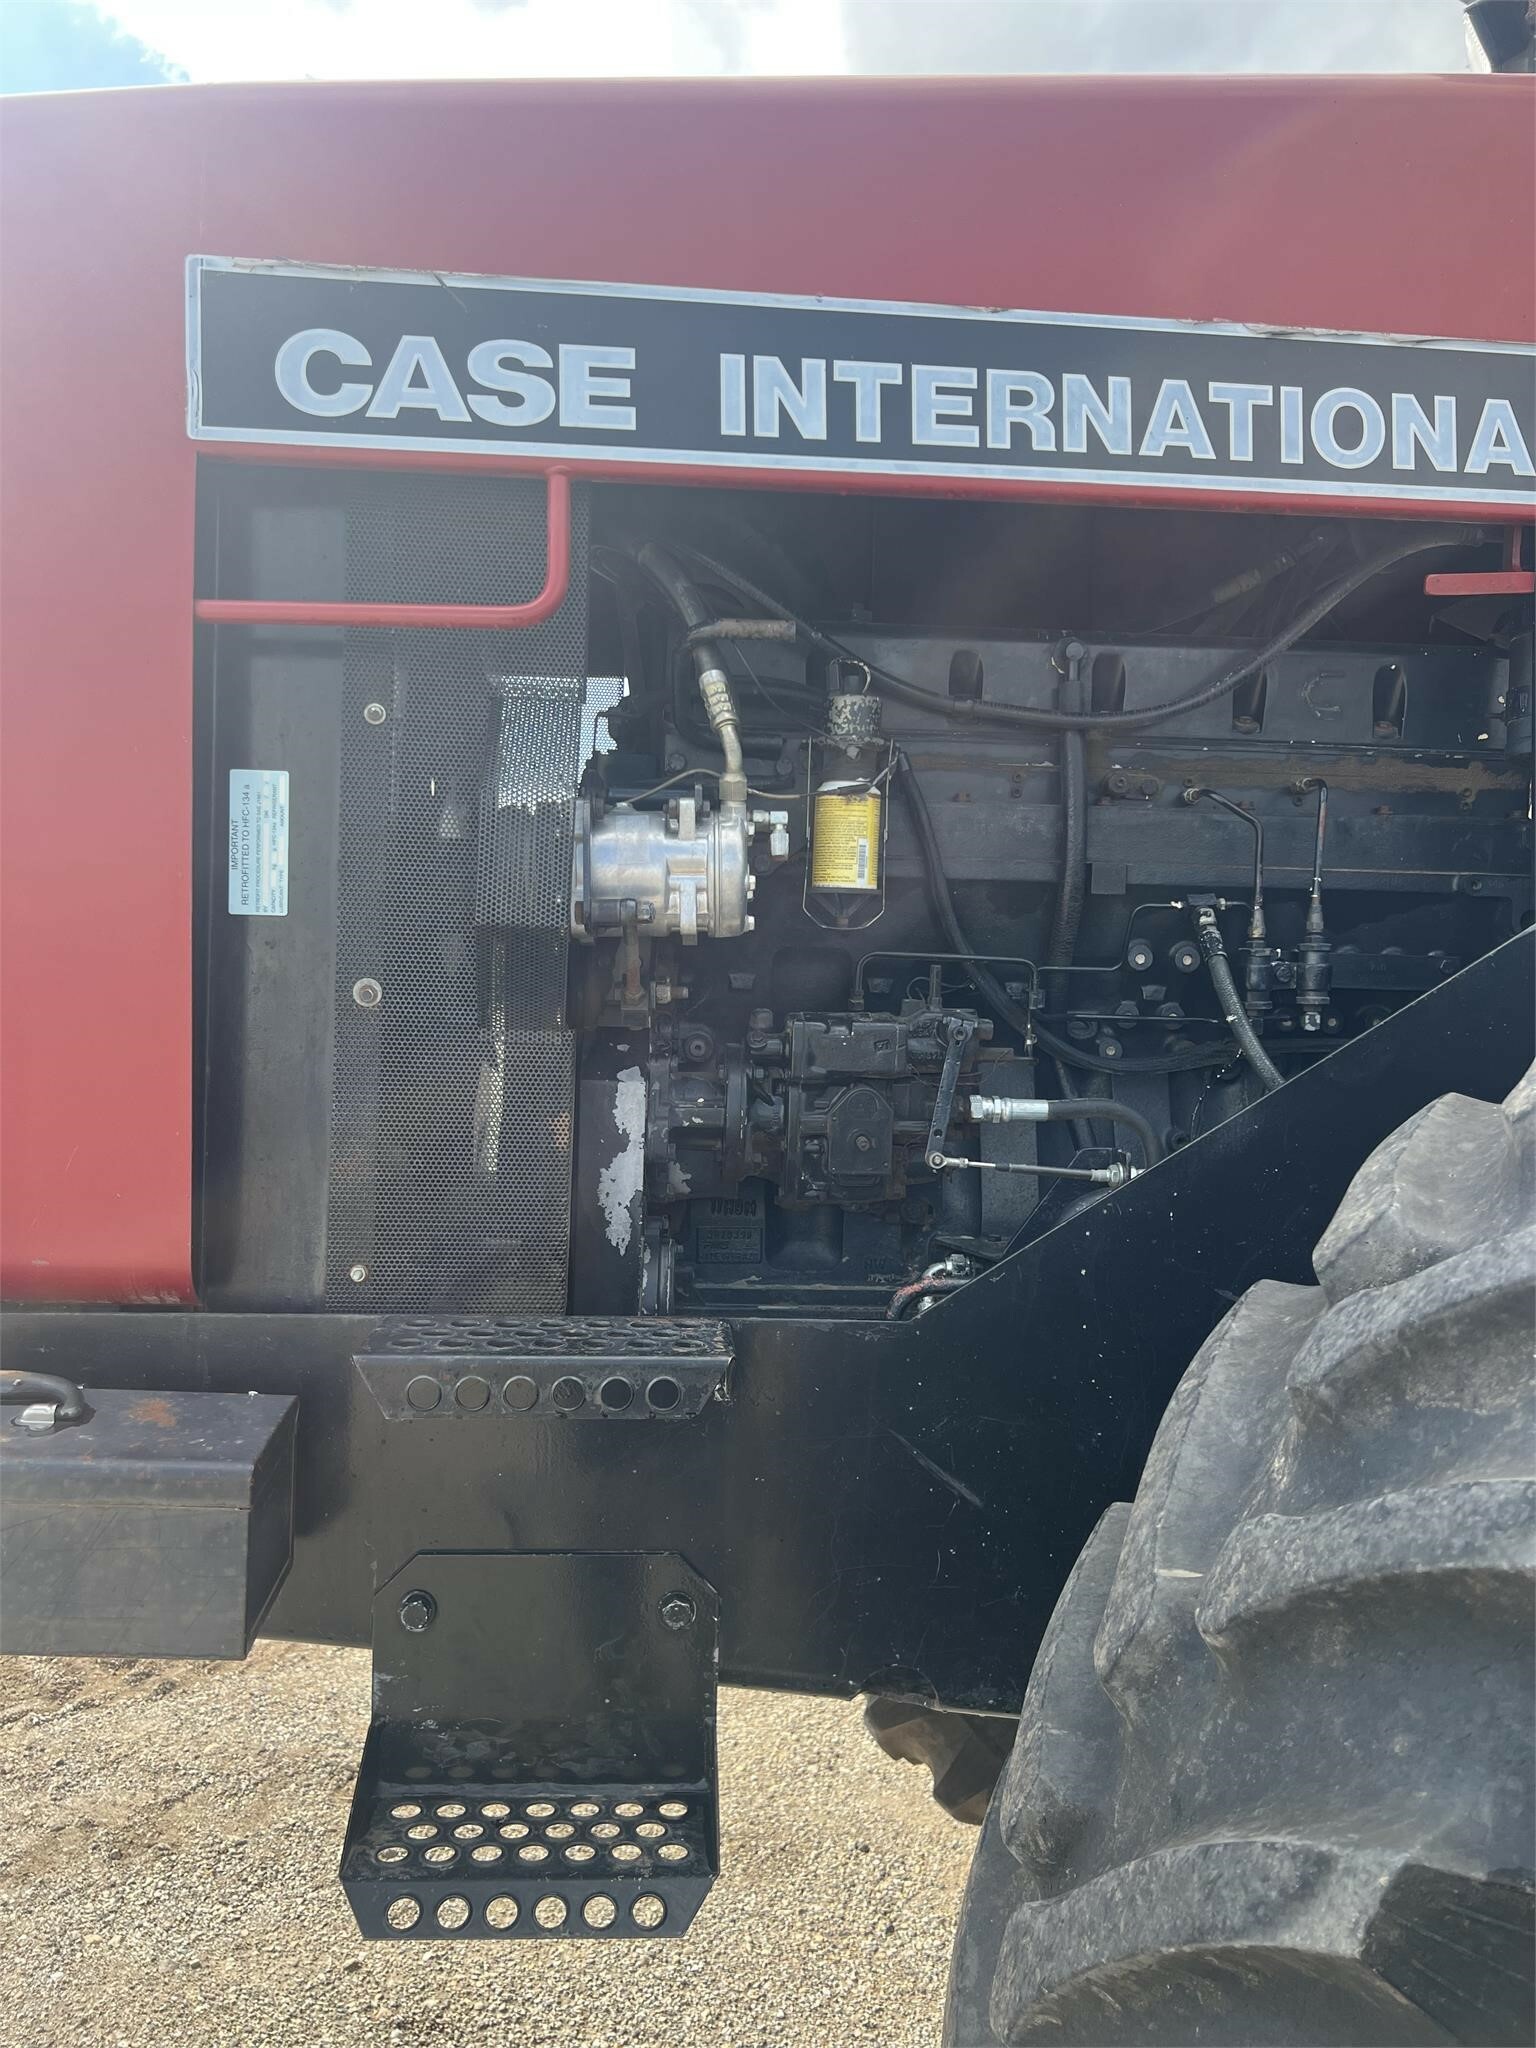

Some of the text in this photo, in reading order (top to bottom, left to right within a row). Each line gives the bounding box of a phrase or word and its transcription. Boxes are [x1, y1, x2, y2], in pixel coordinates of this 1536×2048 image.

[273, 328, 1536, 477] CASE INTERNATIONA
[242, 792, 250, 828] HFC-134
[242, 829, 250, 842] TO
[231, 819, 239, 870] IMPORTANT
[241, 843, 250, 906] RETROFITTED
